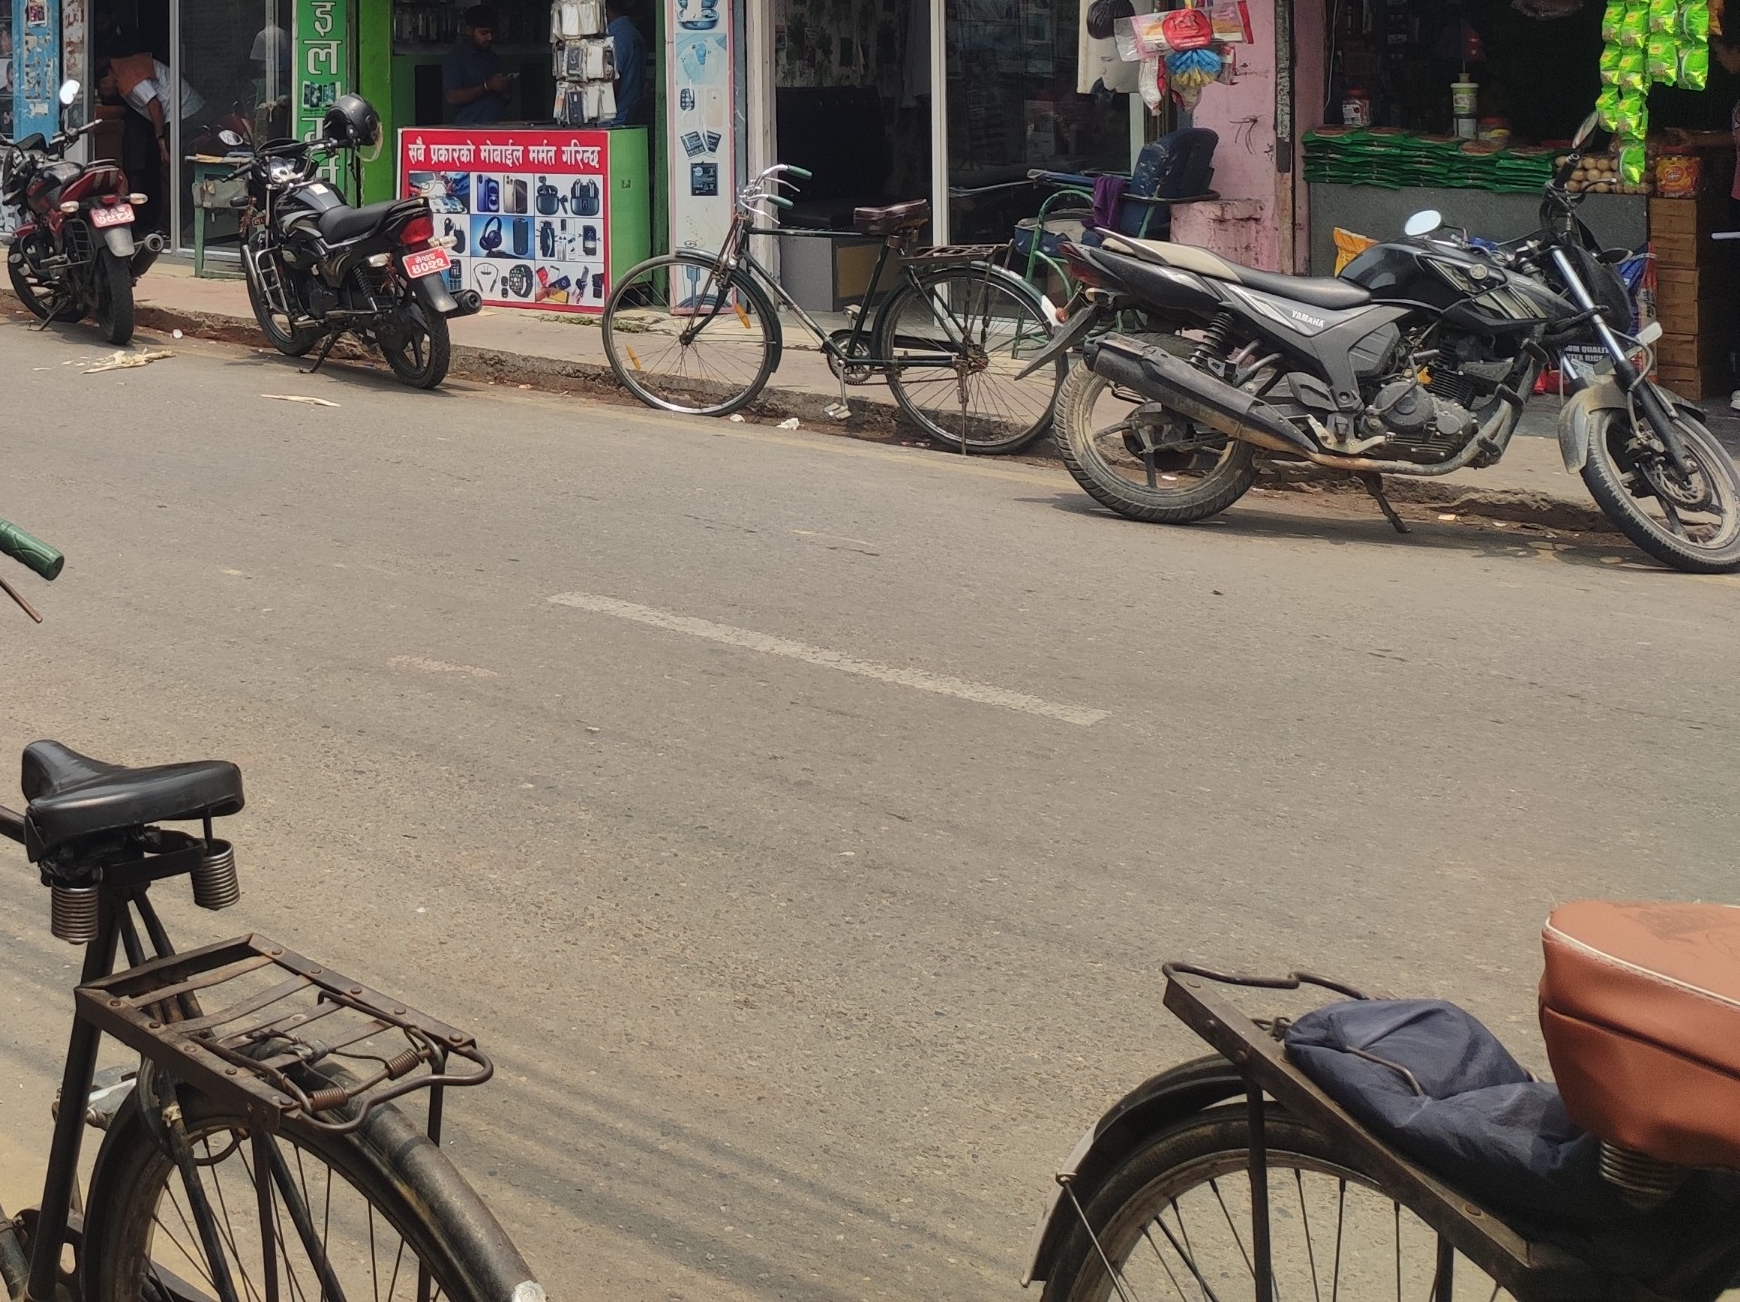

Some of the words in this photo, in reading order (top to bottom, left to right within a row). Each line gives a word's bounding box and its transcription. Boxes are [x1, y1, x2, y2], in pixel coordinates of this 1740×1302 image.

[408, 136, 426, 165] सबै
[430, 139, 476, 167] प्रकारको
[479, 139, 524, 167] मोबाईल
[528, 139, 557, 165] मर्मत
[561, 138, 602, 170] गरिन्छ
[1291, 309, 1325, 328] YAMAHA
[1581, 345, 1610, 354] QUALIT
